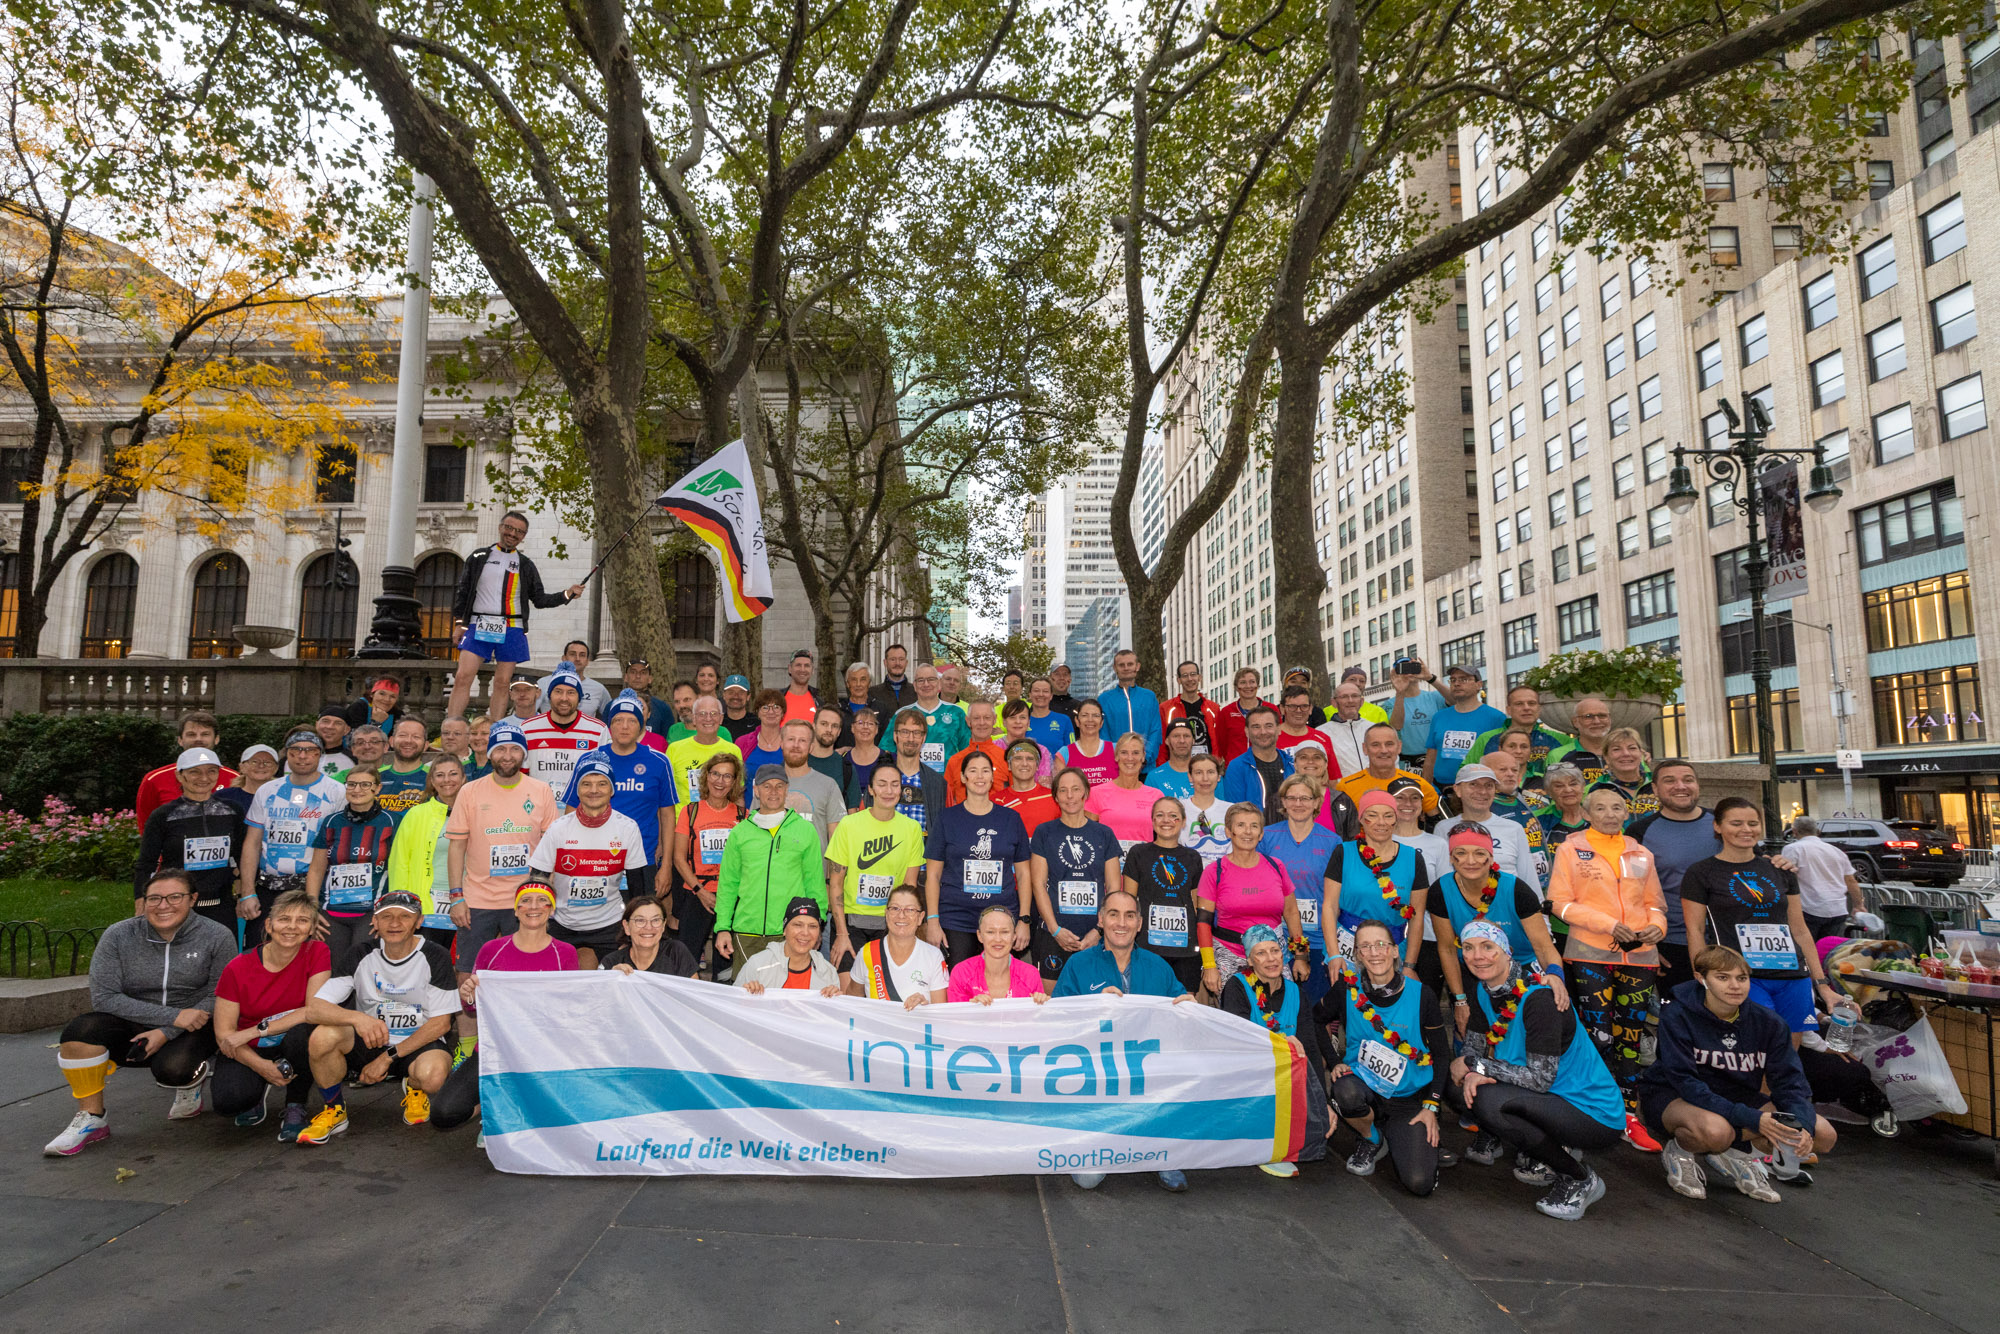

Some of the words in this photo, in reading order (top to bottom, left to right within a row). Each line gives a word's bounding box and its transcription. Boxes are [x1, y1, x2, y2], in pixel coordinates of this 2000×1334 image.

[485, 622, 504, 634] 7828
[1905, 711, 1984, 729] ZARA
[1444, 738, 1450, 746] C
[1451, 738, 1471, 750] 5419
[554, 751, 569, 761] Fly
[923, 751, 942, 761] 5456
[538, 760, 576, 772] Emirat
[1901, 763, 1941, 772] ZARA
[268, 830, 275, 840] K
[277, 830, 302, 844] 7816
[702, 840, 708, 848] L
[862, 834, 894, 857] RUN
[186, 850, 196, 860] K
[199, 847, 226, 862] 7780
[491, 856, 500, 867] H
[501, 854, 527, 868] 8256
[579, 858, 622, 866] Mercedes-Benz
[331, 877, 339, 887] K
[342, 874, 367, 888] 7815
[965, 870, 972, 882] E
[976, 871, 999, 885] 7087
[570, 887, 578, 897] H
[580, 887, 604, 900] 8325
[859, 883, 866, 894] F
[868, 885, 891, 899] 9987
[971, 892, 992, 900] 2019
[1061, 891, 1067, 902] E
[1070, 892, 1095, 906] 6095
[1151, 915, 1157, 926] E
[1158, 916, 1187, 931] 10128
[1745, 937, 1752, 948] J
[1755, 937, 1789, 952] 7034
[1619, 973, 1642, 987] NY
[1593, 991, 1608, 1007] I
[1628, 984, 1654, 1005] NY
[389, 1014, 417, 1028] 7728
[847, 1017, 1161, 1096] interair
[1360, 1049, 1367, 1061] I
[1367, 1055, 1399, 1083] 5802
[1899, 1073, 1917, 1082] You
[596, 1137, 695, 1166] Laufend
[697, 1137, 733, 1159] die
[739, 1139, 794, 1160] Welt
[1037, 1148, 1168, 1171] SportReisen
